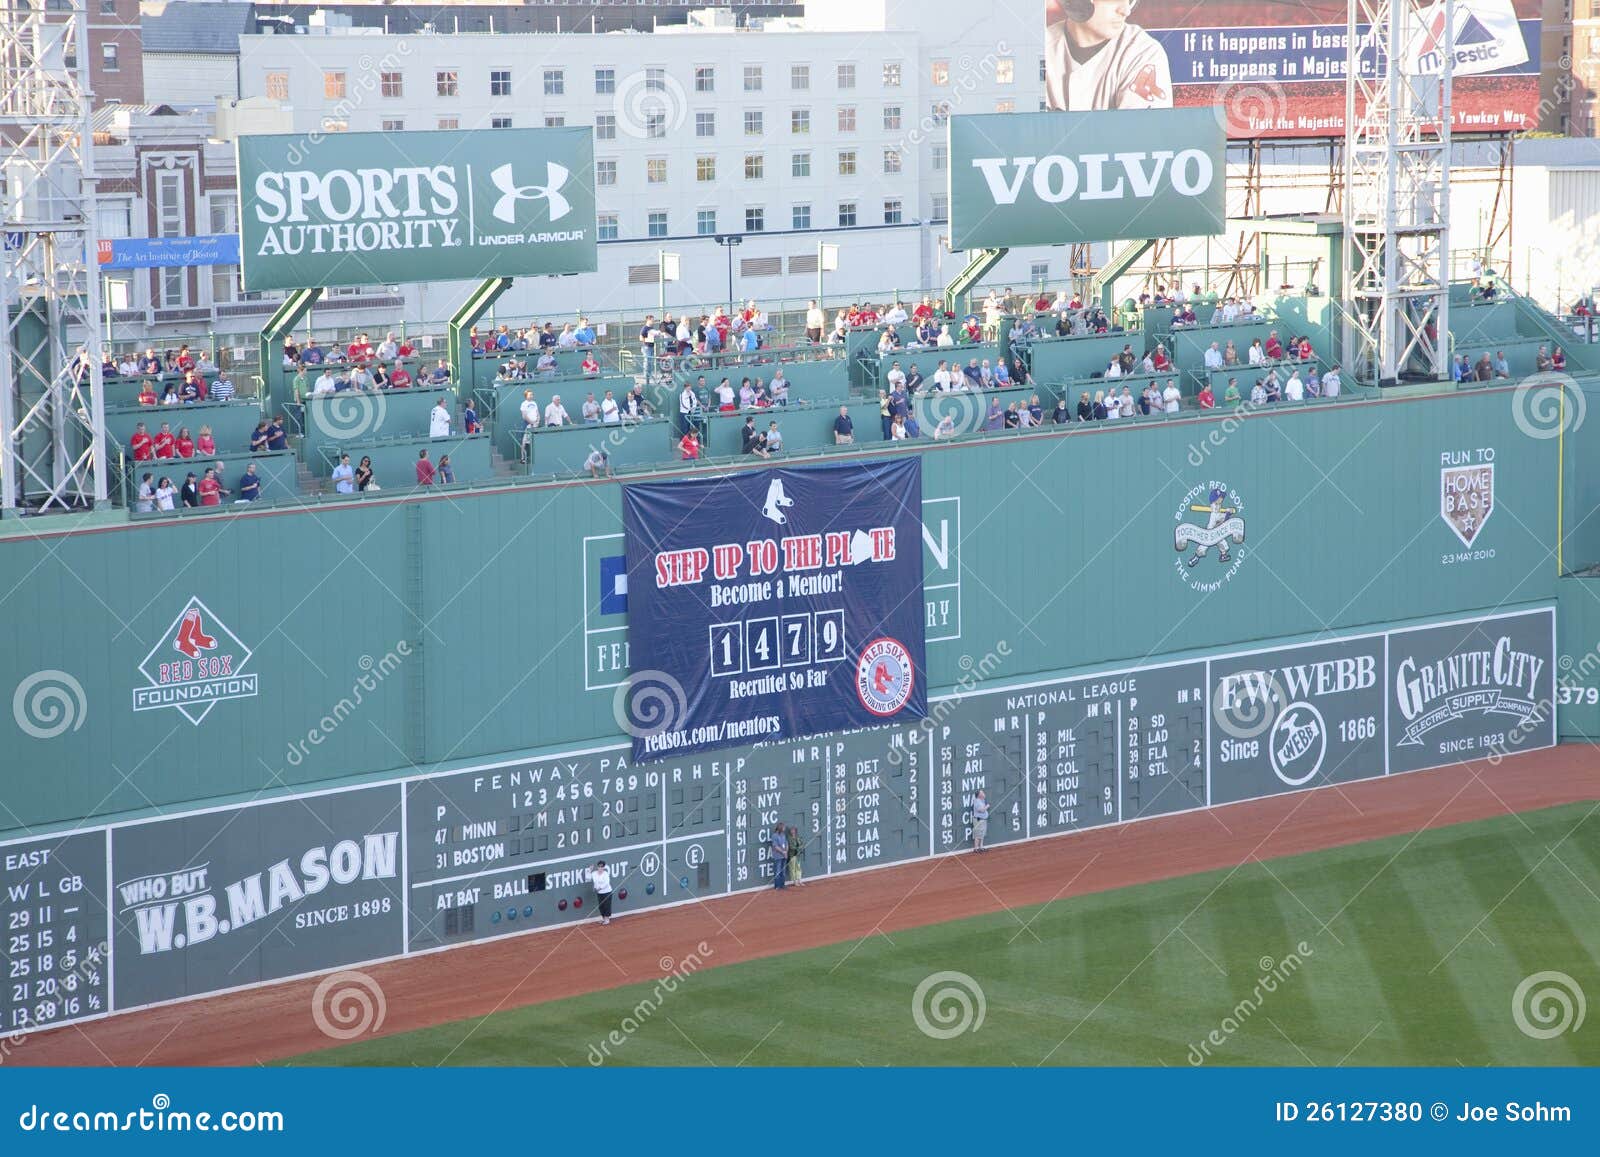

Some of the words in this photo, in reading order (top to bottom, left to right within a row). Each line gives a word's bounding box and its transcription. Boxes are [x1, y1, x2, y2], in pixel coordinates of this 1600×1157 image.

[1184, 32, 1196, 52] If
[1202, 34, 1214, 51] it
[1219, 32, 1287, 54] happens
[1292, 33, 1307, 50] in
[1192, 60, 1204, 77] it
[1209, 58, 1277, 80] happens
[1283, 59, 1297, 76] in
[1249, 116, 1273, 130] Visit
[1277, 117, 1294, 130] the
[1298, 115, 1344, 130] Majestic
[1459, 111, 1500, 126] Yawkey
[1504, 110, 1526, 125] Way
[972, 149, 1214, 205] VOLVO
[255, 165, 459, 224] SPORTS
[479, 233, 525, 246] UNDER
[529, 230, 584, 244] ARMOUR
[1441, 450, 1471, 466] RUN
[1476, 447, 1495, 462] TO
[1209, 480, 1227, 493] RED
[1446, 472, 1489, 493] HOME
[1174, 483, 1205, 521] BOSTON
[1229, 489, 1244, 513] SOX
[1446, 492, 1489, 512] BASE
[655, 548, 708, 588] STEP
[712, 542, 743, 580] UP
[747, 539, 778, 576] TO
[782, 534, 822, 571] THE
[1225, 548, 1246, 582] FUND
[1441, 554, 1455, 564] 23
[1456, 551, 1473, 562] MAY
[1474, 549, 1496, 561] 2010
[1174, 557, 1190, 582] THE
[711, 580, 772, 607] Become
[777, 580, 784, 598] a
[788, 570, 843, 598] Mentor!
[1190, 579, 1222, 593] JIMMY
[864, 643, 884, 664] RED
[885, 643, 905, 662] SOX
[159, 659, 193, 684] RED
[198, 655, 233, 679] SOX
[789, 671, 804, 690] So
[806, 669, 828, 688] Far
[1283, 655, 1377, 700] WEBB
[137, 678, 255, 706] FOUNDATION
[1007, 689, 1076, 711] NATIONAL
[1083, 679, 1136, 700] LEAGUE
[1452, 692, 1496, 711] SUPPLY
[1559, 687, 1599, 705] 379
[1498, 700, 1532, 715] COMPANY
[1128, 717, 1138, 731] 29
[1151, 714, 1165, 728] SD
[1339, 716, 1376, 742] 1866
[1410, 707, 1450, 736] ELECTRIC
[644, 714, 781, 753] redsox.com/mentors
[1058, 728, 1076, 743] MIL
[1129, 733, 1139, 747] 22
[1148, 729, 1168, 744] LAD
[1283, 726, 1314, 759] WEBB
[1439, 736, 1475, 754] SINCE
[1479, 732, 1505, 749] 1923
[965, 743, 981, 758] SF
[1058, 744, 1076, 759] PIT
[1129, 749, 1139, 763] 39
[1148, 745, 1168, 760] FLA
[1220, 739, 1259, 763] Since
[835, 763, 846, 779] 38
[857, 759, 879, 775] DET
[964, 759, 982, 774] ARI
[1056, 760, 1078, 775] COL
[1148, 761, 1168, 777] STL
[735, 780, 747, 795] 33
[762, 776, 778, 790] TB
[856, 776, 880, 791] OAK
[962, 776, 985, 791] NYM
[1056, 776, 1079, 791] HOU
[757, 792, 782, 808] NYY
[857, 793, 880, 809] TOR
[1058, 793, 1077, 808] CIN
[761, 811, 778, 826] KC
[835, 815, 847, 829] 23
[857, 810, 880, 826] SEA
[1058, 809, 1077, 824] ATL
[434, 828, 448, 845] 47
[462, 820, 497, 841] MINN
[835, 832, 847, 846] 54
[857, 827, 880, 843] LAA
[5, 849, 51, 871] EAST
[436, 852, 448, 870] 31
[453, 843, 504, 867] BOSTON
[857, 843, 881, 859] CWS
[8, 884, 29, 902] W
[39, 881, 50, 898] L
[59, 875, 83, 894] GB
[118, 876, 168, 906] WHO
[170, 868, 209, 896] BUT
[436, 892, 455, 910] AT
[457, 887, 481, 907] BAT
[494, 879, 529, 900] BALL
[9, 910, 30, 929] 29
[295, 904, 349, 930] SINCE
[353, 897, 392, 922] 1898
[9, 934, 30, 954] 25
[38, 930, 53, 949] 15
[66, 925, 77, 943] 4
[9, 958, 30, 978] 25
[38, 955, 53, 973] 18
[13, 983, 29, 1002] 21
[36, 978, 56, 997] 20
[12, 1008, 28, 1026] 13
[36, 1002, 56, 1021] 28
[64, 997, 80, 1016] 16
